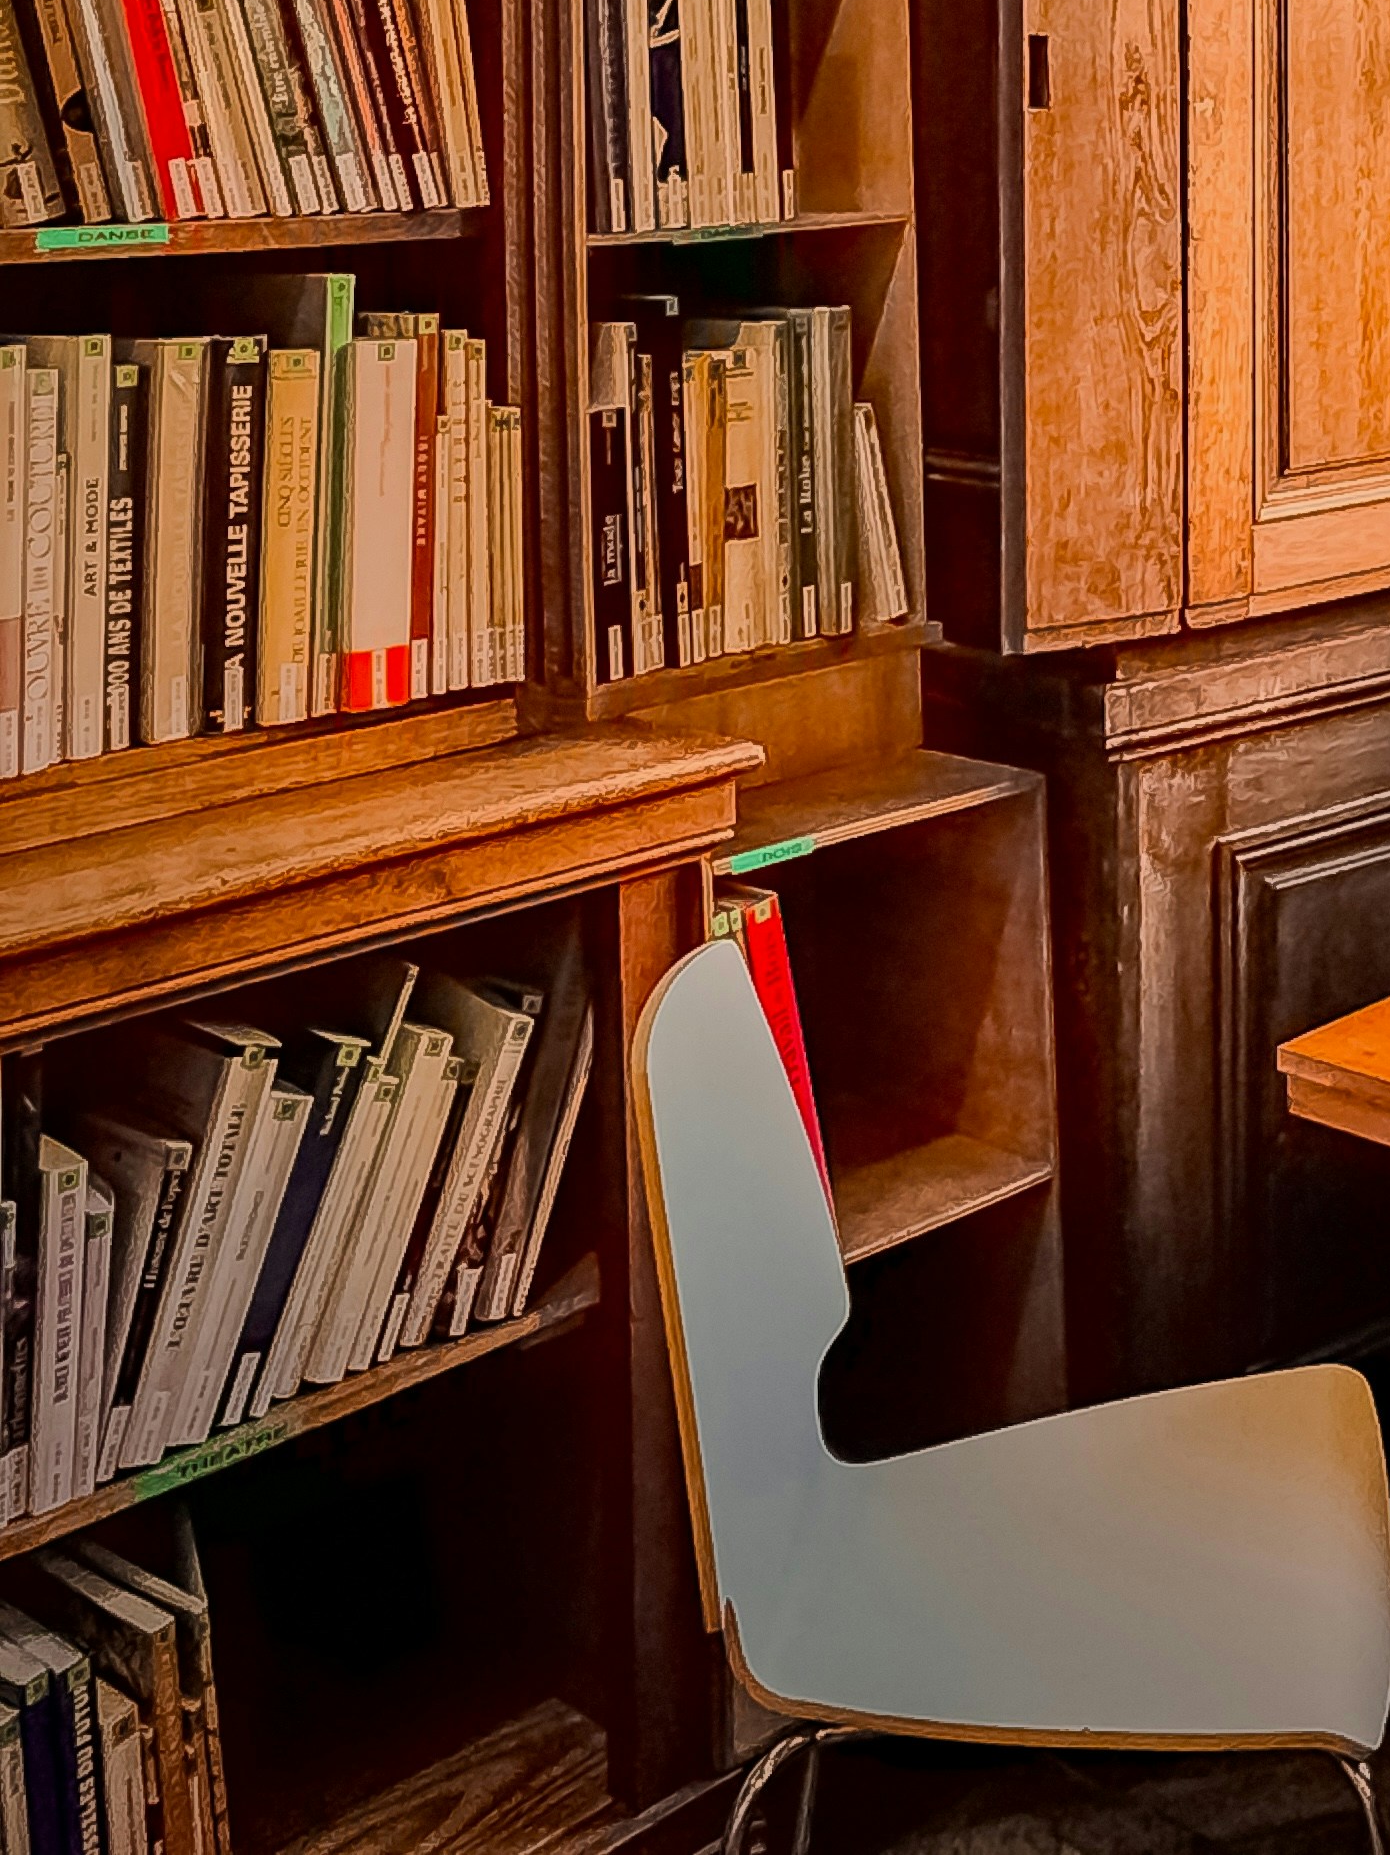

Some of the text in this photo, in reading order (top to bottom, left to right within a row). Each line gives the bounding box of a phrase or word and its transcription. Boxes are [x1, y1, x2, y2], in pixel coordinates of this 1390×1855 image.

[83, 477, 100, 597] ART & MODE
[224, 384, 253, 668] A NOUVELLE TAPISSERIE
[416, 488, 428, 547] MIYAKE
[26, 598, 51, 700] OUVRE
[106, 496, 133, 705] 000 ANS DE TEXTILES
